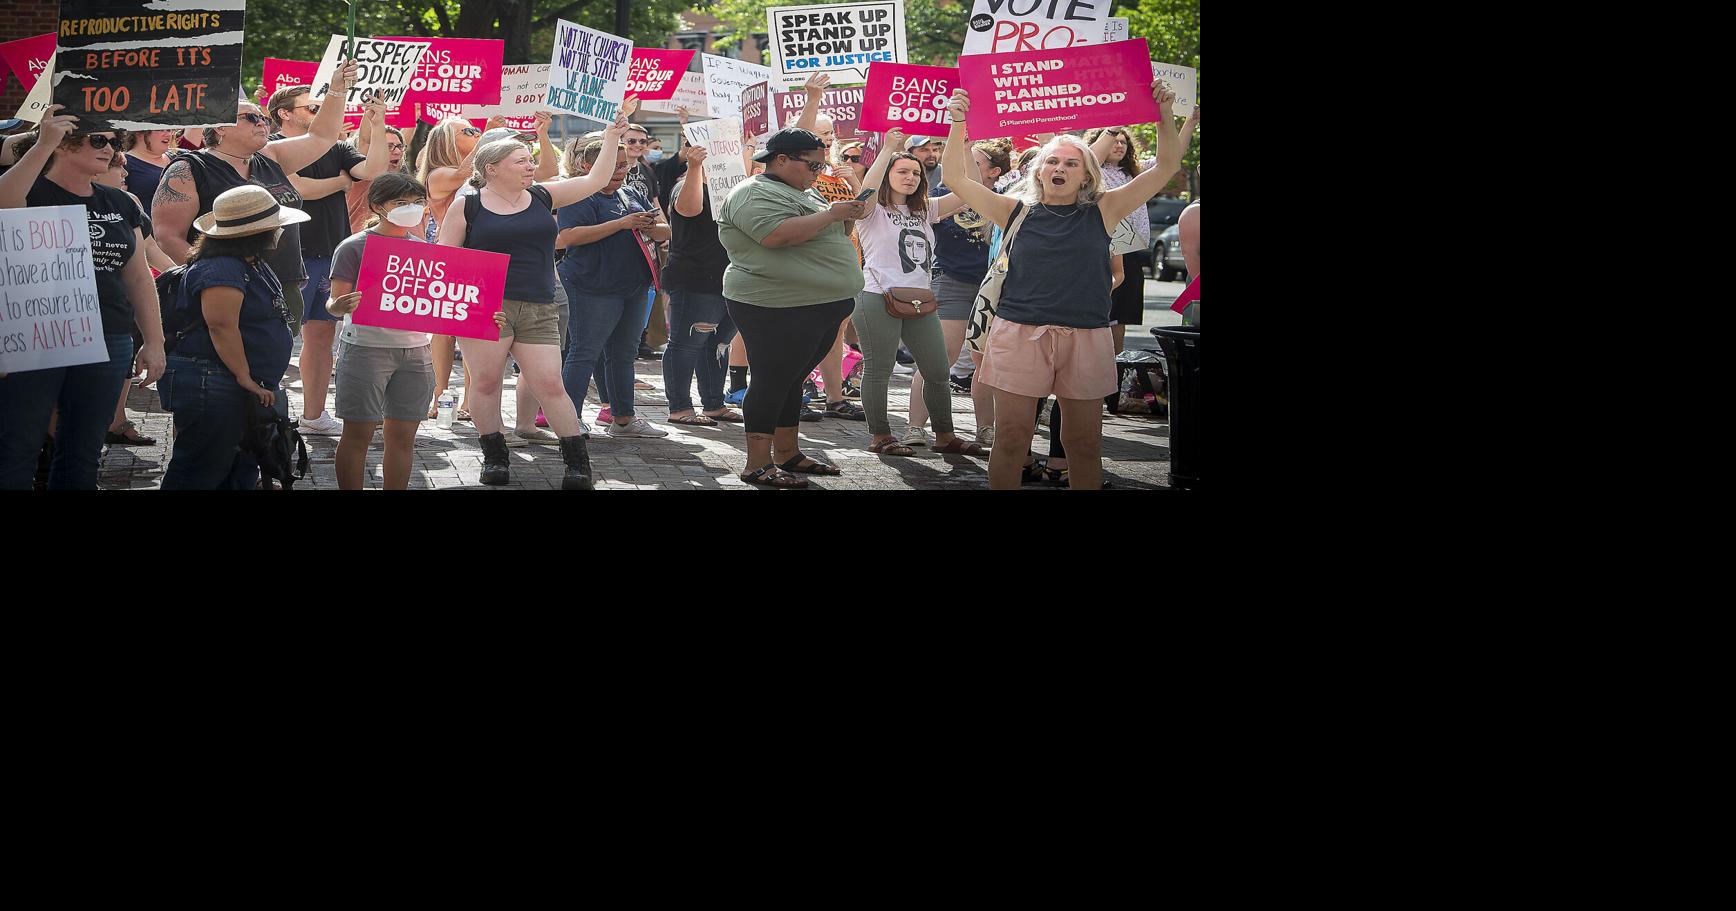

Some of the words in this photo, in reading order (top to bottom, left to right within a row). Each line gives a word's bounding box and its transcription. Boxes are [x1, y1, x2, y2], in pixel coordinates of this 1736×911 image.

[781, 11, 853, 28] SPEAK
[859, 9, 888, 23] UP
[781, 26, 856, 43] STAND
[862, 24, 891, 37] UP
[559, 25, 578, 50] NOT
[577, 30, 593, 54] THE
[593, 36, 629, 64] CHURCH
[784, 39, 852, 57] SHOW
[859, 38, 888, 52] UP
[86, 50, 161, 70] BEFORE
[177, 48, 212, 66] IT'S
[419, 50, 451, 64] ANS
[558, 47, 577, 70] NOT
[576, 51, 592, 74] THE
[591, 57, 620, 82] STATE
[785, 57, 821, 70] FOR
[825, 51, 892, 67] JUSTICE
[336, 63, 409, 85] ODILY
[414, 64, 436, 77] FF
[437, 65, 482, 79] OUR
[627, 69, 646, 80] FF
[646, 69, 674, 81] OUR
[991, 64, 998, 75] I
[1002, 59, 1064, 75] STAND
[408, 77, 473, 93] ODIES
[566, 70, 579, 91] WE
[625, 80, 665, 92] ODIES
[892, 76, 948, 95] BANS
[993, 74, 1044, 88] WITH
[81, 86, 130, 112] TOO
[150, 83, 208, 114] LATE
[515, 93, 545, 104] BODY
[782, 89, 864, 109] ABRTION
[888, 91, 931, 108] OFF
[994, 84, 1081, 101] PLANNED
[547, 86, 579, 112] DECIDE
[578, 94, 597, 117] OUR
[594, 98, 618, 122] FATE
[996, 92, 1126, 114] PARENTHOOD
[887, 106, 953, 125] BODIE
[1035, 114, 1077, 123] Parenthood
[689, 124, 710, 142] MY
[709, 140, 740, 156] UTERUS
[817, 185, 851, 196] CLINI
[12, 227, 24, 252] is
[29, 219, 74, 250] BOLD
[65, 244, 88, 254] enough
[92, 249, 122, 257] bortion,
[5, 257, 39, 286] have
[41, 262, 49, 283] a
[51, 253, 90, 280] child.
[386, 255, 446, 280] BANS
[382, 274, 427, 296] OFF
[428, 281, 480, 304] OUR
[5, 291, 21, 320] to
[25, 294, 71, 317] ensure
[73, 287, 99, 313] they
[379, 292, 469, 321] BODIES
